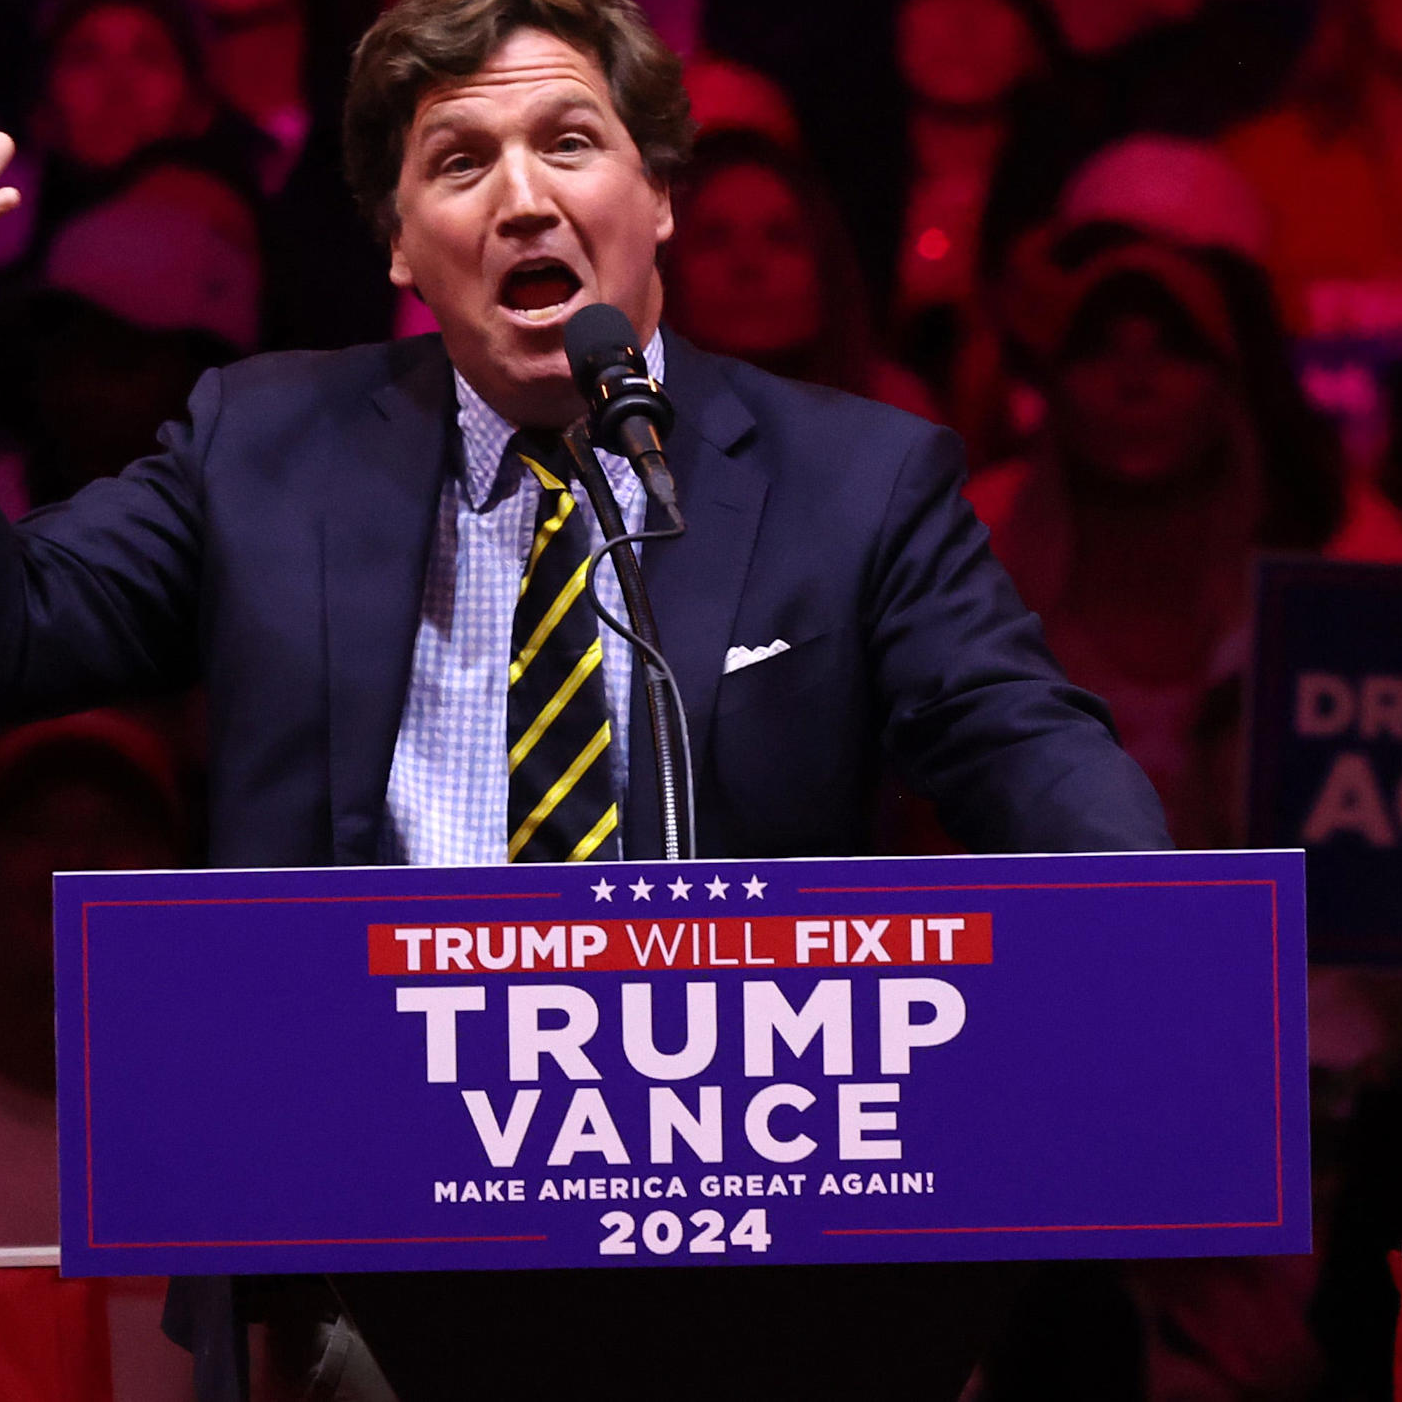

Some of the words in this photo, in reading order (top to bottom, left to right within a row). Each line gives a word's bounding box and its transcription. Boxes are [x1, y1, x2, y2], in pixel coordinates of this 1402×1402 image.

[395, 925, 608, 971] TRUMP
[625, 921, 776, 966] WILL
[795, 919, 892, 964] FIX
[909, 917, 965, 961] IT
[395, 977, 967, 1084] TRUMP
[461, 1082, 902, 1168] VANCE
[434, 1179, 526, 1203] MAKE
[538, 1175, 688, 1201] AMERICA
[699, 1173, 806, 1199] GREAT
[819, 1171, 935, 1196] AGAIN!
[598, 1207, 772, 1255] 2024
